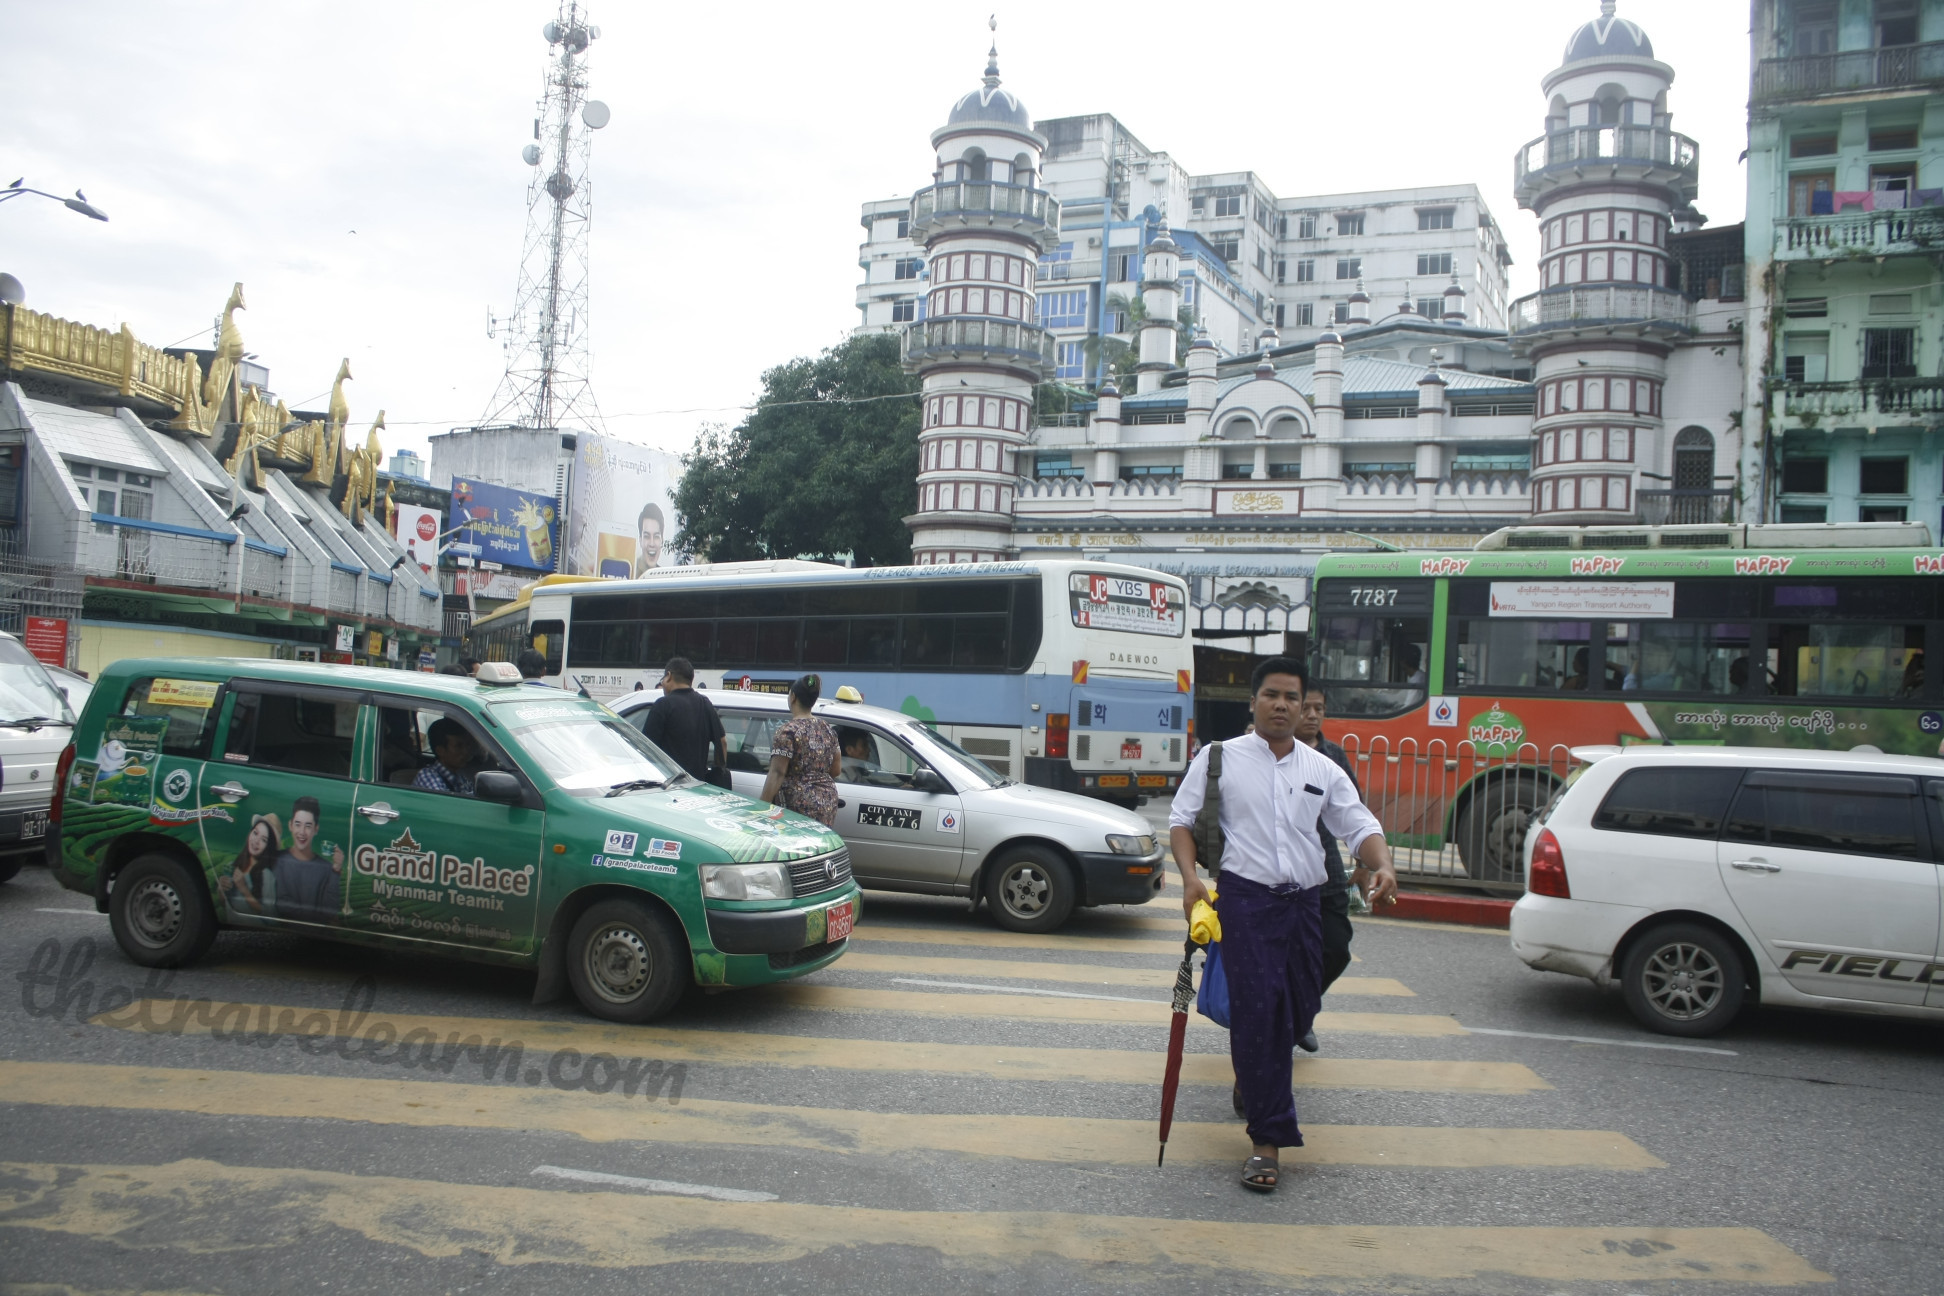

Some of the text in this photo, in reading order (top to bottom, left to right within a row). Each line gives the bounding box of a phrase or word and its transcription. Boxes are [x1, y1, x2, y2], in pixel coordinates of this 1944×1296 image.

[1420, 557, 1471, 575] HAPPY
[1571, 556, 1624, 574] HAPPY
[1735, 555, 1792, 574] HAPPY
[1115, 580, 1143, 597] YBS
[1350, 588, 1398, 607] 7787
[1531, 601, 1652, 610] Yangon Region Transport Authority
[1109, 652, 1158, 665] DAEWOO
[1094, 703, 1169, 727] 화 신
[1675, 710, 1727, 731] အားလုံး
[1732, 711, 1784, 732] အားလုံး
[1470, 724, 1523, 743] HAPPY
[151, 804, 177, 821] Original
[867, 805, 913, 817] CITY TAXI
[356, 845, 530, 896] Grand Palace
[604, 857, 678, 875] /grandpalaceteamix
[373, 879, 505, 911] Myanmar Teamix
